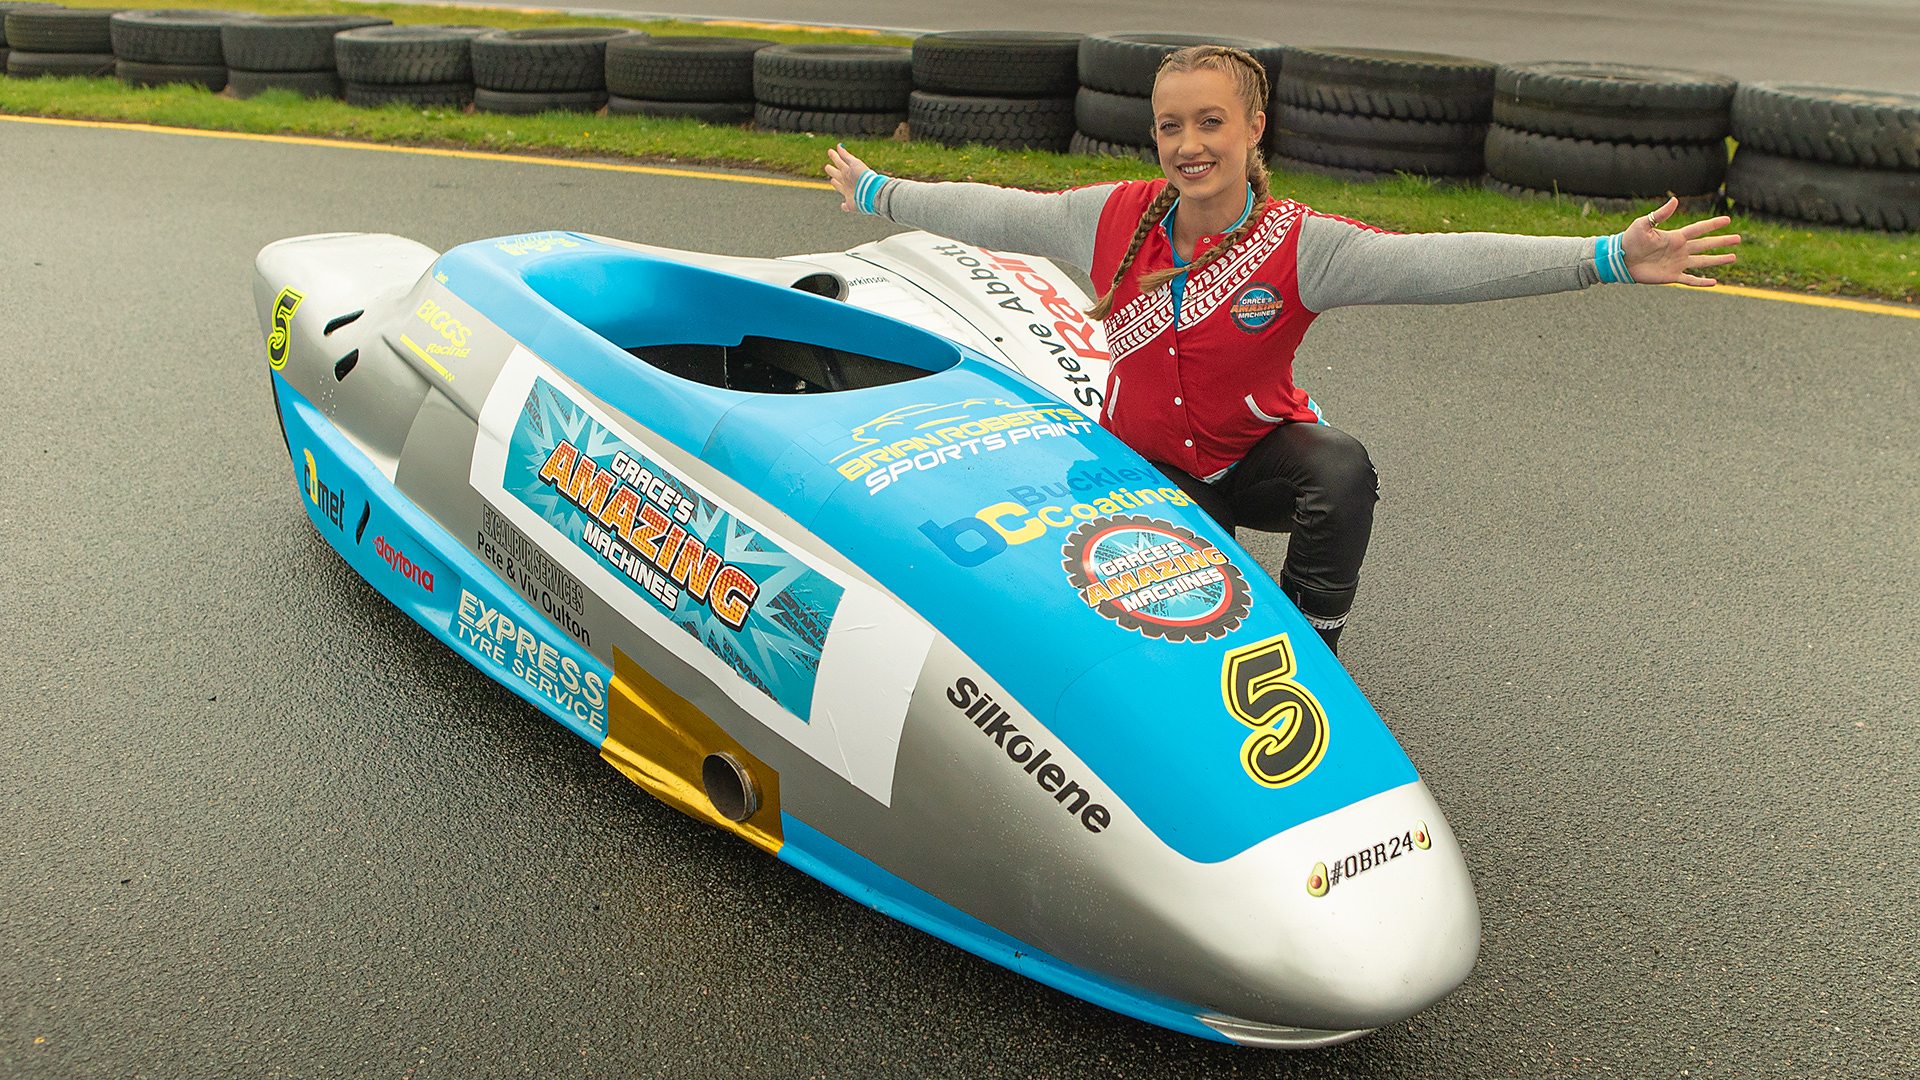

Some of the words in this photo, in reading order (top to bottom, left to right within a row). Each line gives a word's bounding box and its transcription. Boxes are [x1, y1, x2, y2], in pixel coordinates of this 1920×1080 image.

[932, 244, 1035, 315] Abbott
[1230, 300, 1284, 313] AMAZING
[1237, 309, 1276, 319] MACHINES
[267, 285, 307, 371] 5
[415, 299, 473, 348] BIGGS
[1028, 323, 1104, 409] Steve
[836, 433, 945, 482] BRIAN
[935, 408, 1086, 443] ROBERTS
[864, 433, 1007, 496] SPORTS
[1007, 421, 1092, 446] PAINT
[610, 450, 696, 524] GRACE'S
[1007, 464, 1162, 508] Buckley
[372, 535, 435, 594] daytona
[483, 503, 534, 575] EXCALIBUR
[533, 550, 584, 616] SERVICES
[538, 438, 761, 632] AMAZING
[583, 521, 680, 611] MACHINES
[1098, 541, 1185, 577] GRACE'S
[477, 530, 504, 570] Pete
[506, 557, 517, 583] &
[519, 567, 539, 602] Viv
[541, 591, 592, 647] Oulton
[1085, 546, 1229, 608] AMAZING
[1118, 568, 1226, 613] MACHINES
[457, 621, 506, 666] TYRE
[511, 659, 604, 732] SERVICE
[458, 588, 606, 710] EXPRESS
[1221, 632, 1331, 789] 5
[946, 676, 1112, 834] Silkolene
